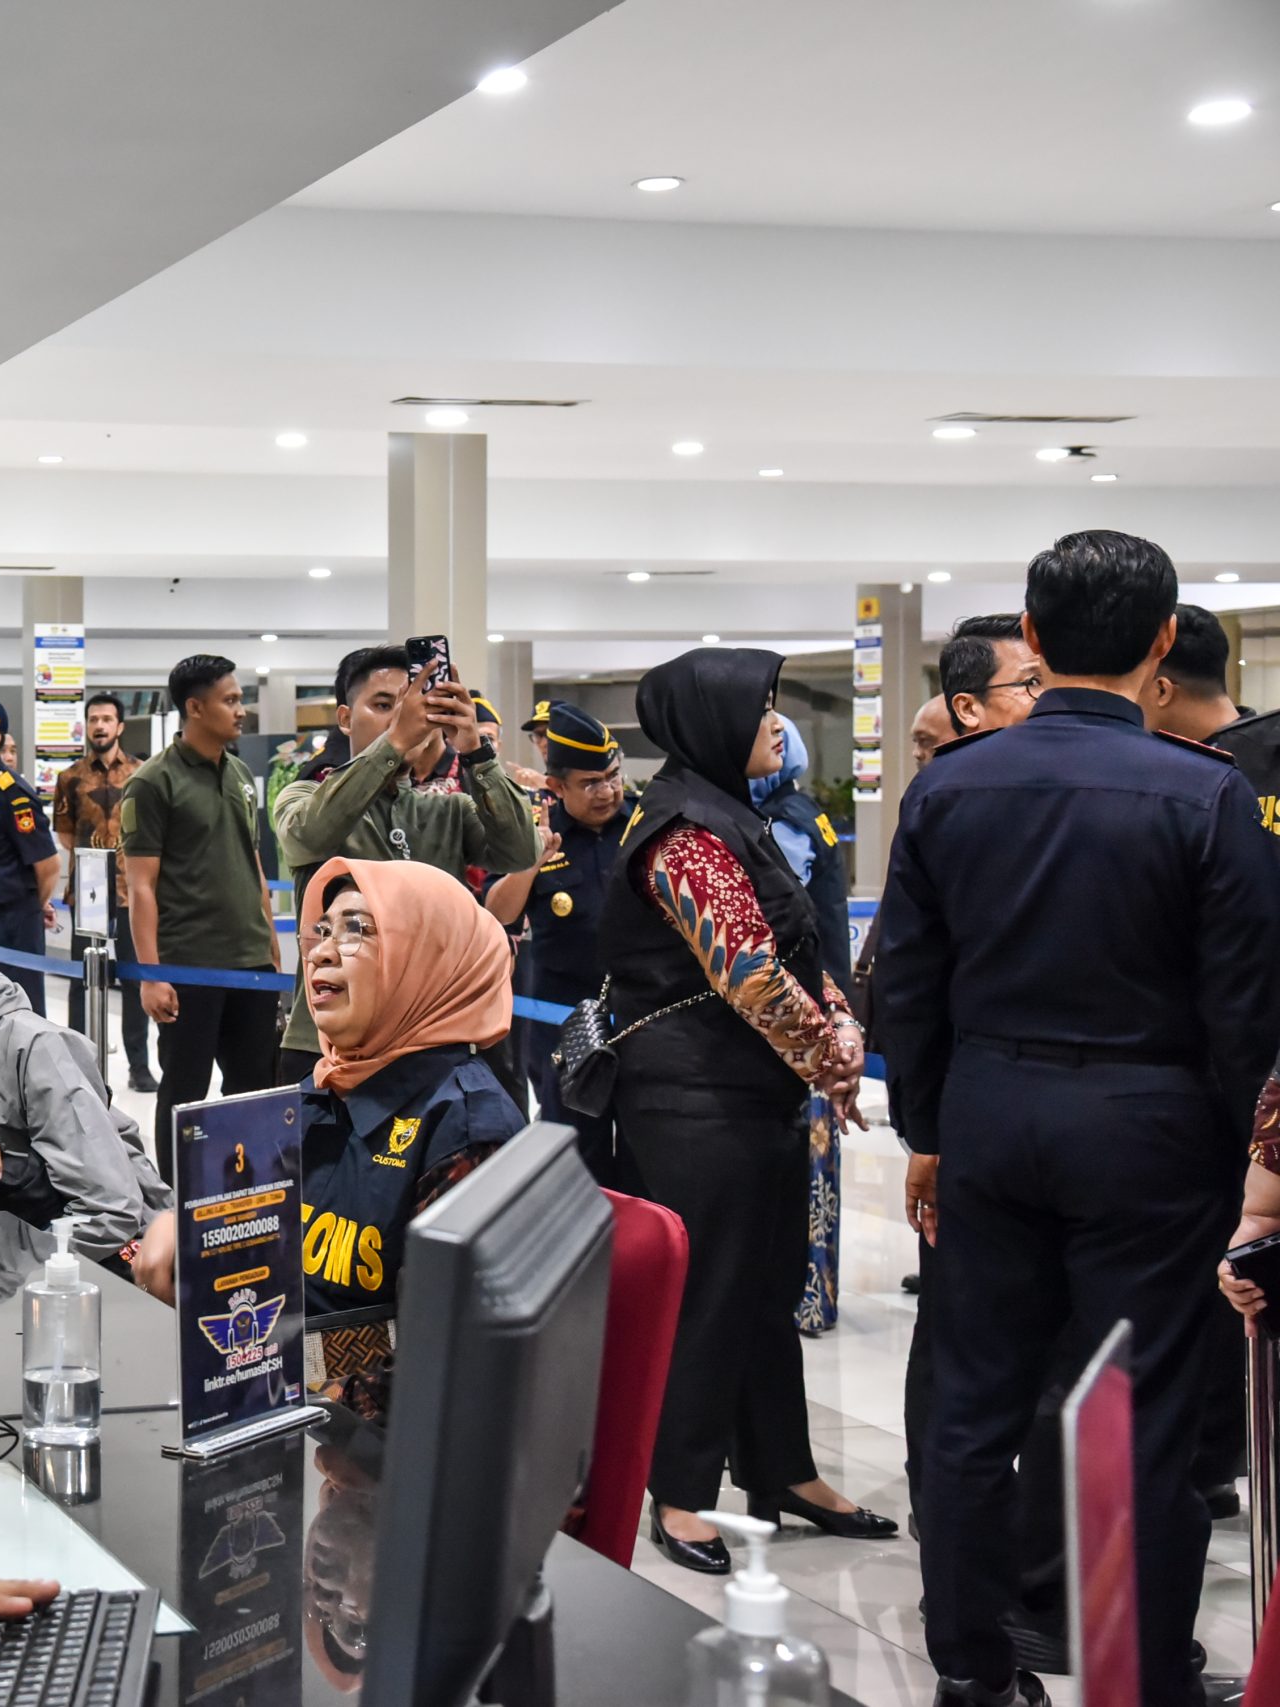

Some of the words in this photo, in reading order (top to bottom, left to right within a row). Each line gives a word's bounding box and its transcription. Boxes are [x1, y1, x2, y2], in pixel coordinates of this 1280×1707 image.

[235, 1143, 245, 1173] 3
[372, 1154, 407, 1168] CUSTOMS
[201, 1215, 280, 1248] 1550020200088
[204, 1356, 283, 1392] linktr.ee/humasBCSH
